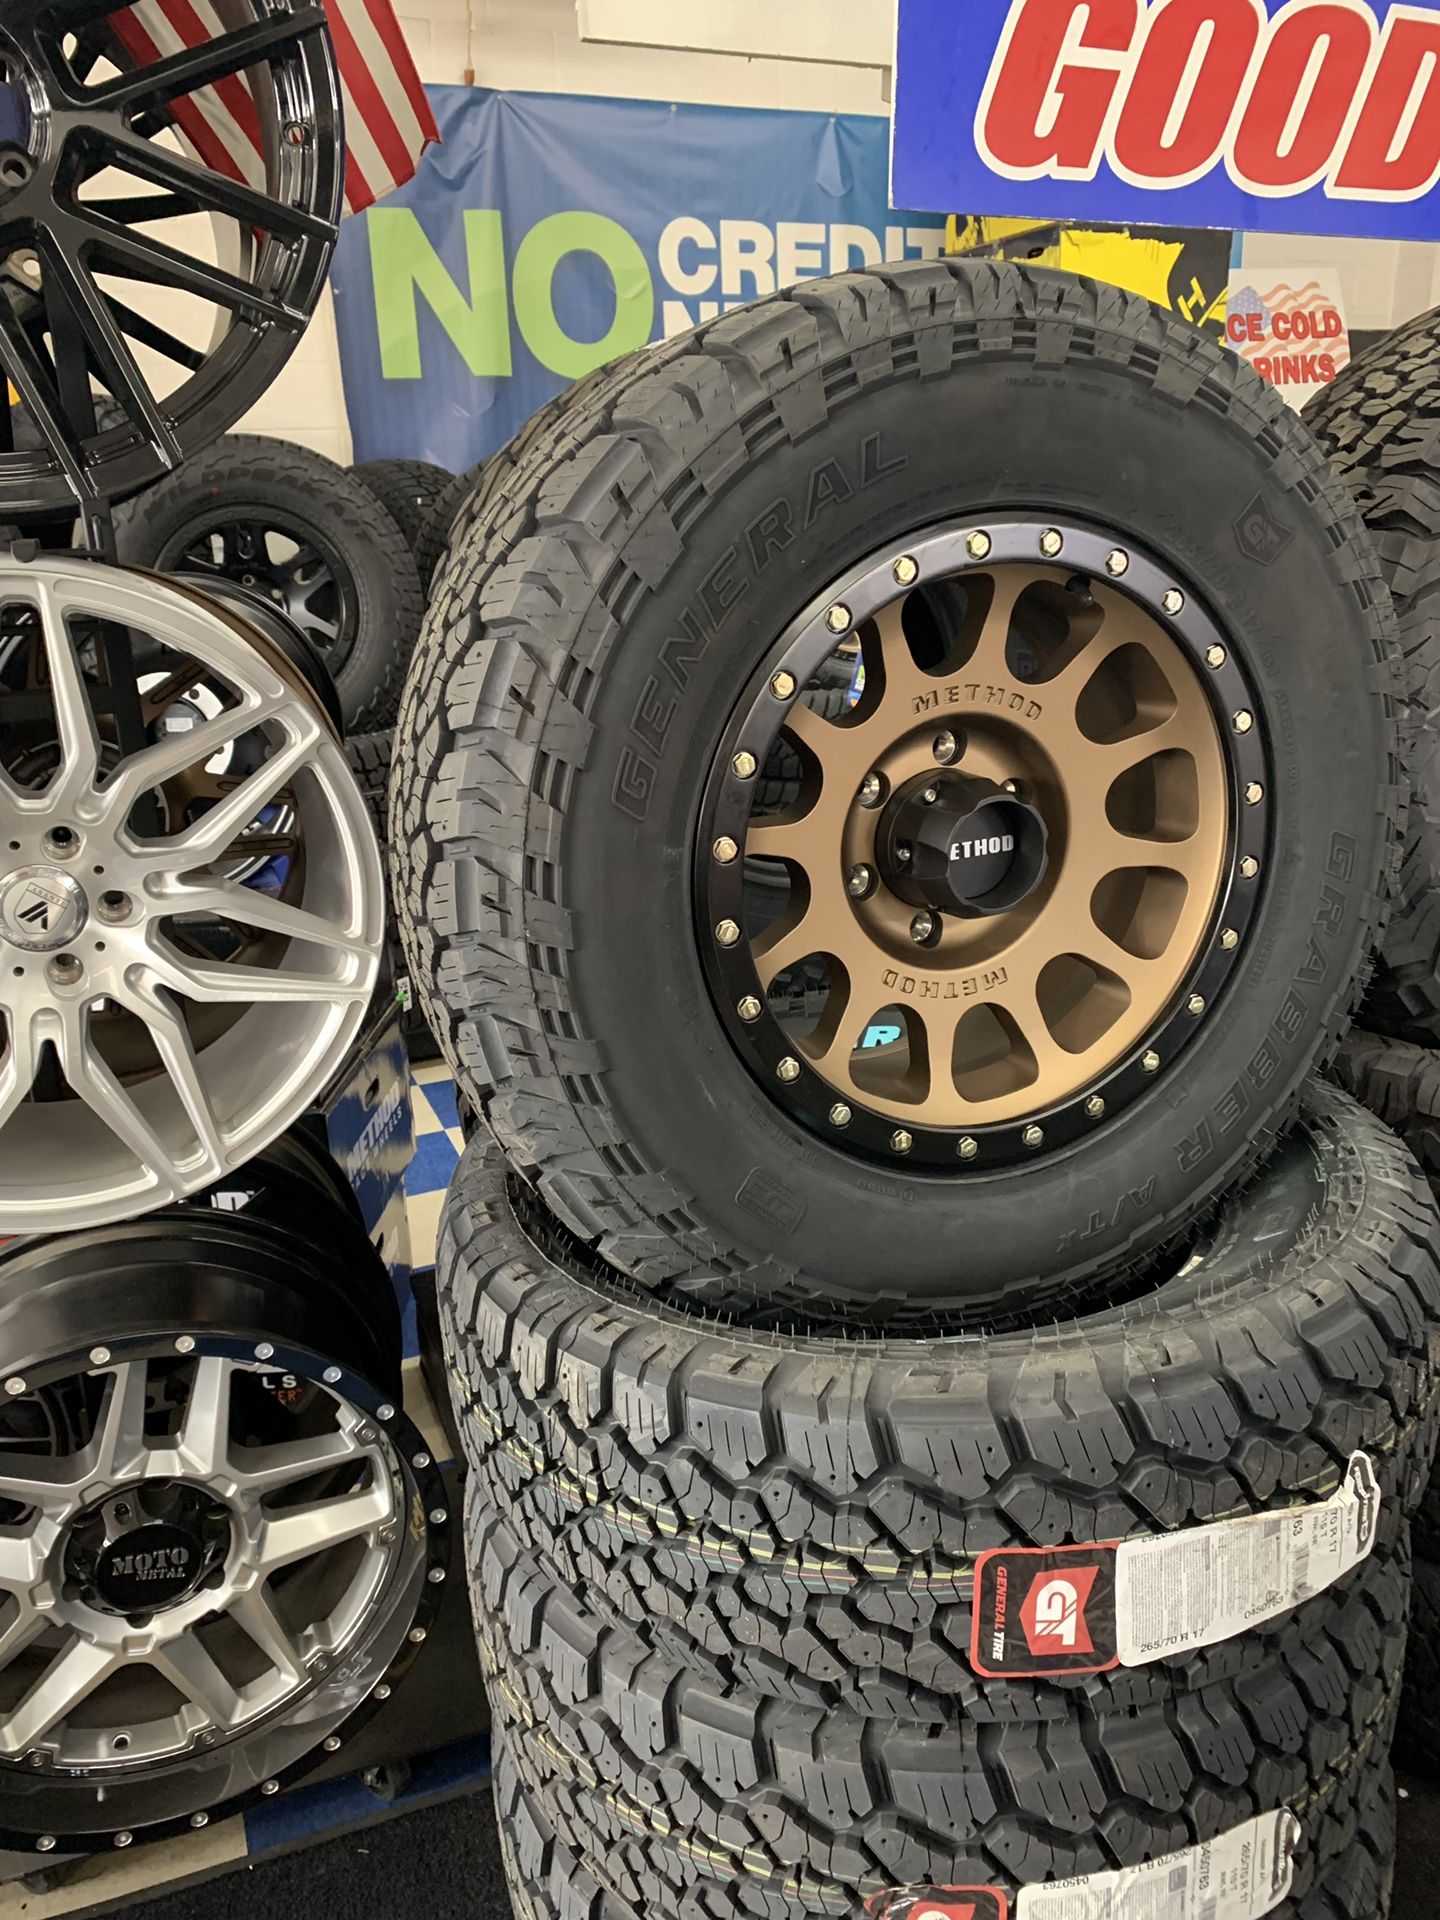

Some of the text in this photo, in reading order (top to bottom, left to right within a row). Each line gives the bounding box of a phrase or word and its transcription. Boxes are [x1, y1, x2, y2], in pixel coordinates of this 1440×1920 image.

[974, 0, 1440, 203] GOOD
[366, 206, 655, 380] NO
[1225, 310, 1343, 343] CE COLD
[1253, 353, 1336, 385] RINKS
[611, 431, 909, 821] GENERAL
[911, 684, 1043, 721] METHOD
[949, 834, 1015, 861] ETHOD
[880, 966, 1008, 1000] METHOD
[1172, 829, 1359, 1175] GRABBER
[111, 1547, 190, 1576] MOTO
[135, 1565, 186, 1581] METAL
[992, 1565, 1008, 1661] GENERAL TIRE
[1244, 1595, 1284, 1620] 0450763
[1140, 1627, 1206, 1653] 265/70 R 17
[1042, 1876, 1090, 1890] 0450763
